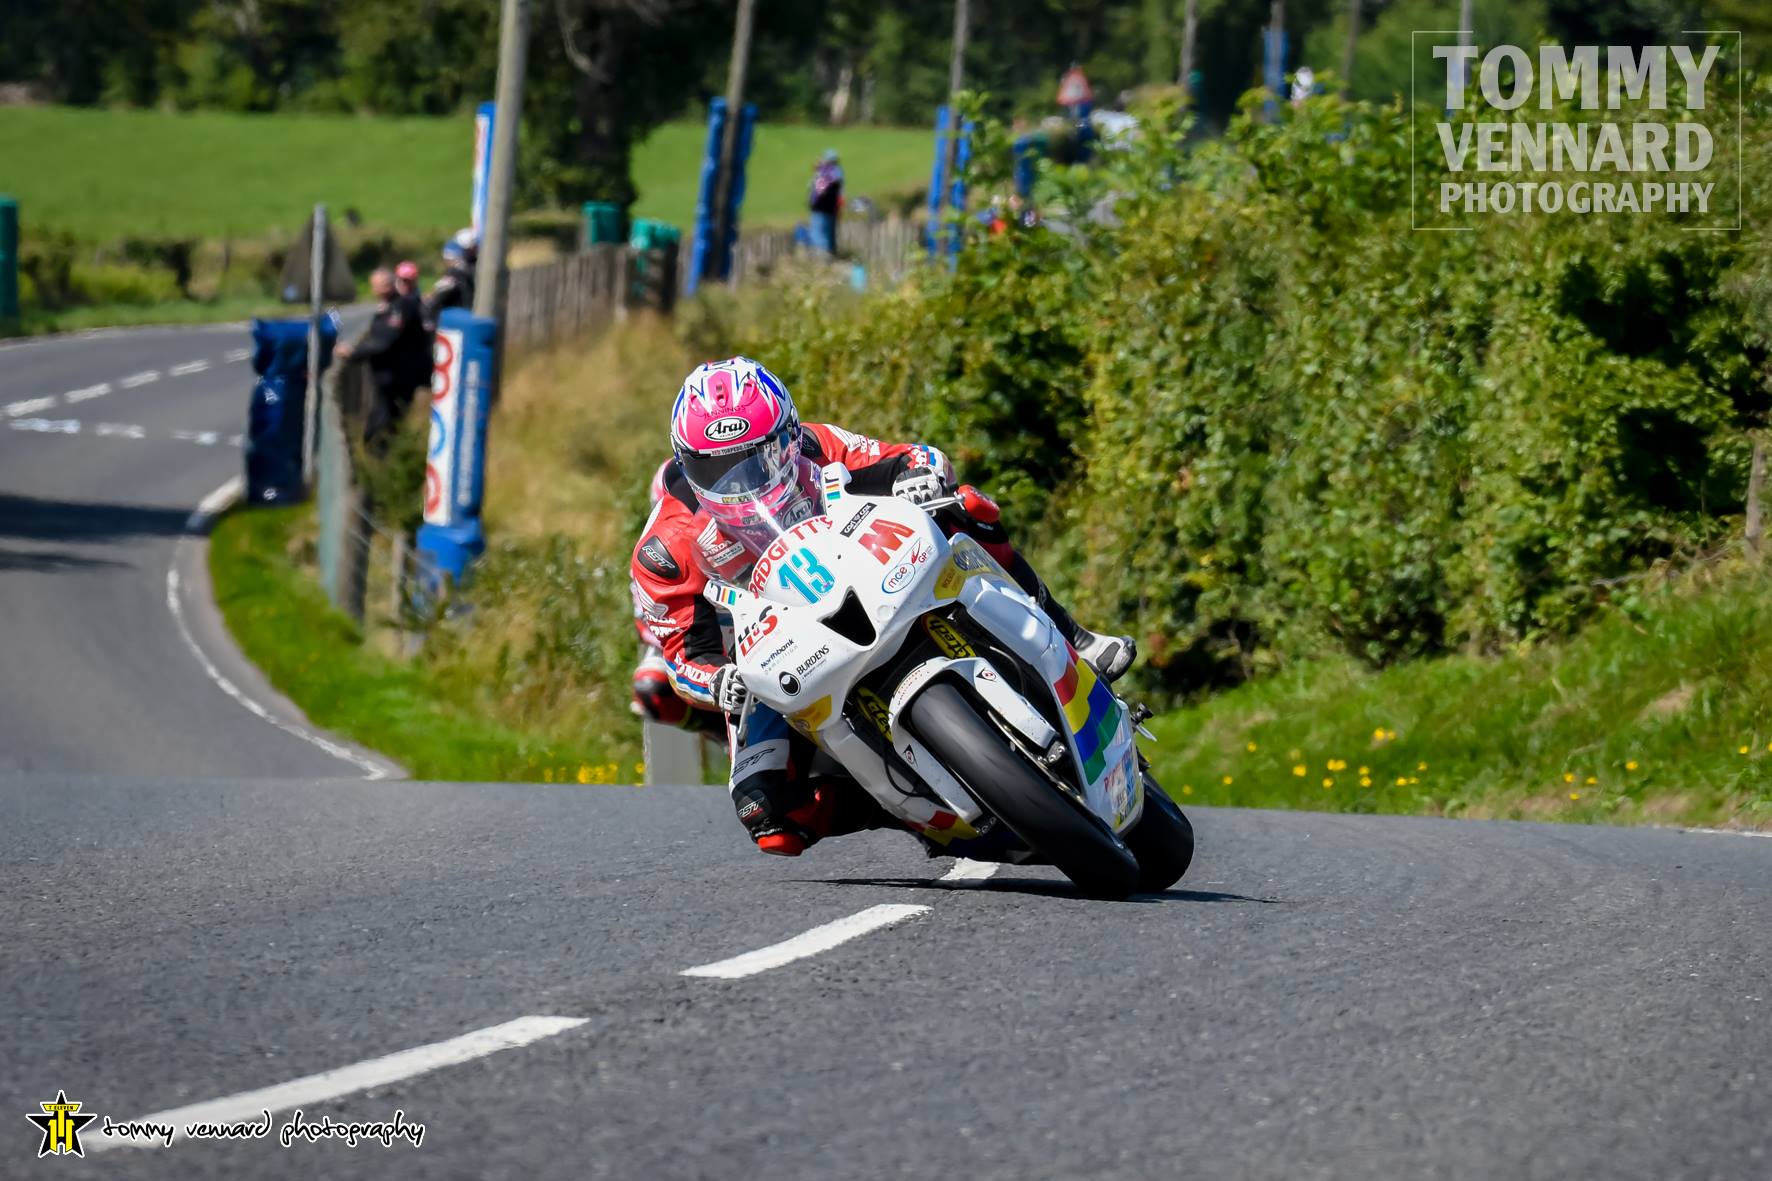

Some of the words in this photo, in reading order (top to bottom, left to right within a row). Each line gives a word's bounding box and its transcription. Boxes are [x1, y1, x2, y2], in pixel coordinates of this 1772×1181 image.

[708, 421, 744, 437] Arai
[641, 545, 676, 569] RST
[777, 546, 836, 605] 13
[760, 639, 794, 669] Northbank
[795, 644, 830, 676] BURDENS
